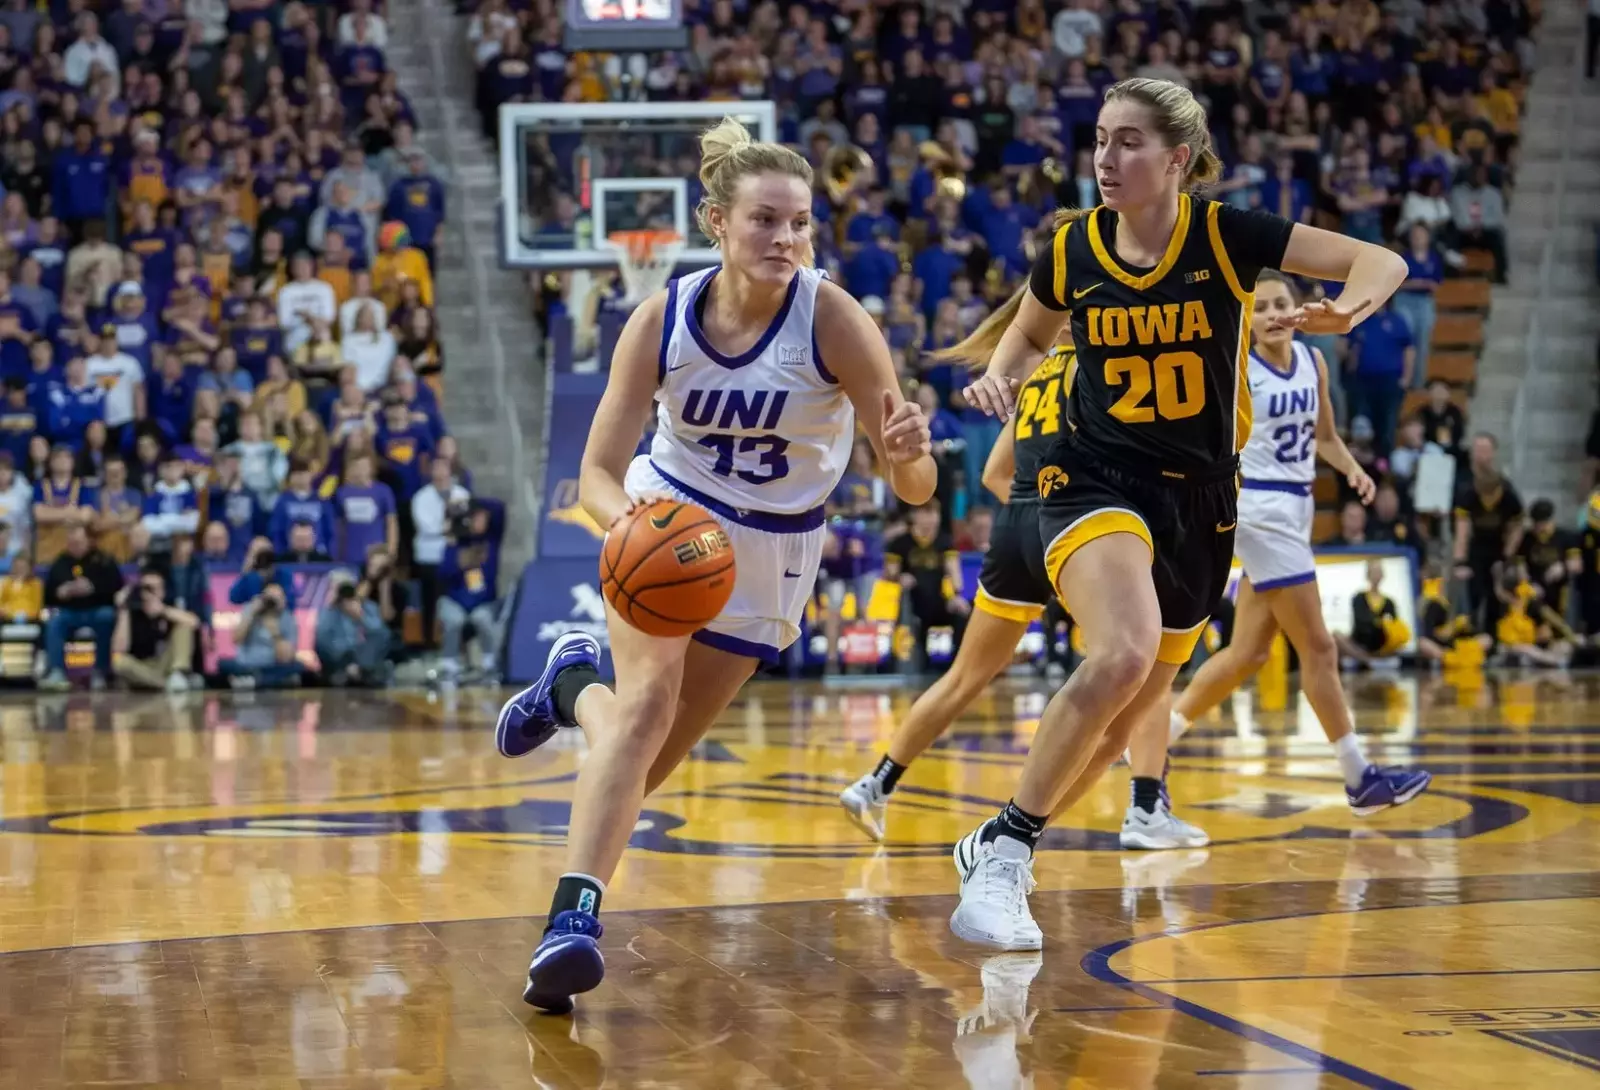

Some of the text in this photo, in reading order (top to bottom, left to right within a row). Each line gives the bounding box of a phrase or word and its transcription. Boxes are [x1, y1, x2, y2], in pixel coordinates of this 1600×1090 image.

[1087, 300, 1213, 346] IOWA
[681, 390, 789, 430] UNI
[1016, 378, 1060, 440] 24
[1104, 351, 1206, 423] 20
[1268, 387, 1315, 418] UNI
[697, 433, 791, 485] 13
[1272, 420, 1316, 463] 22
